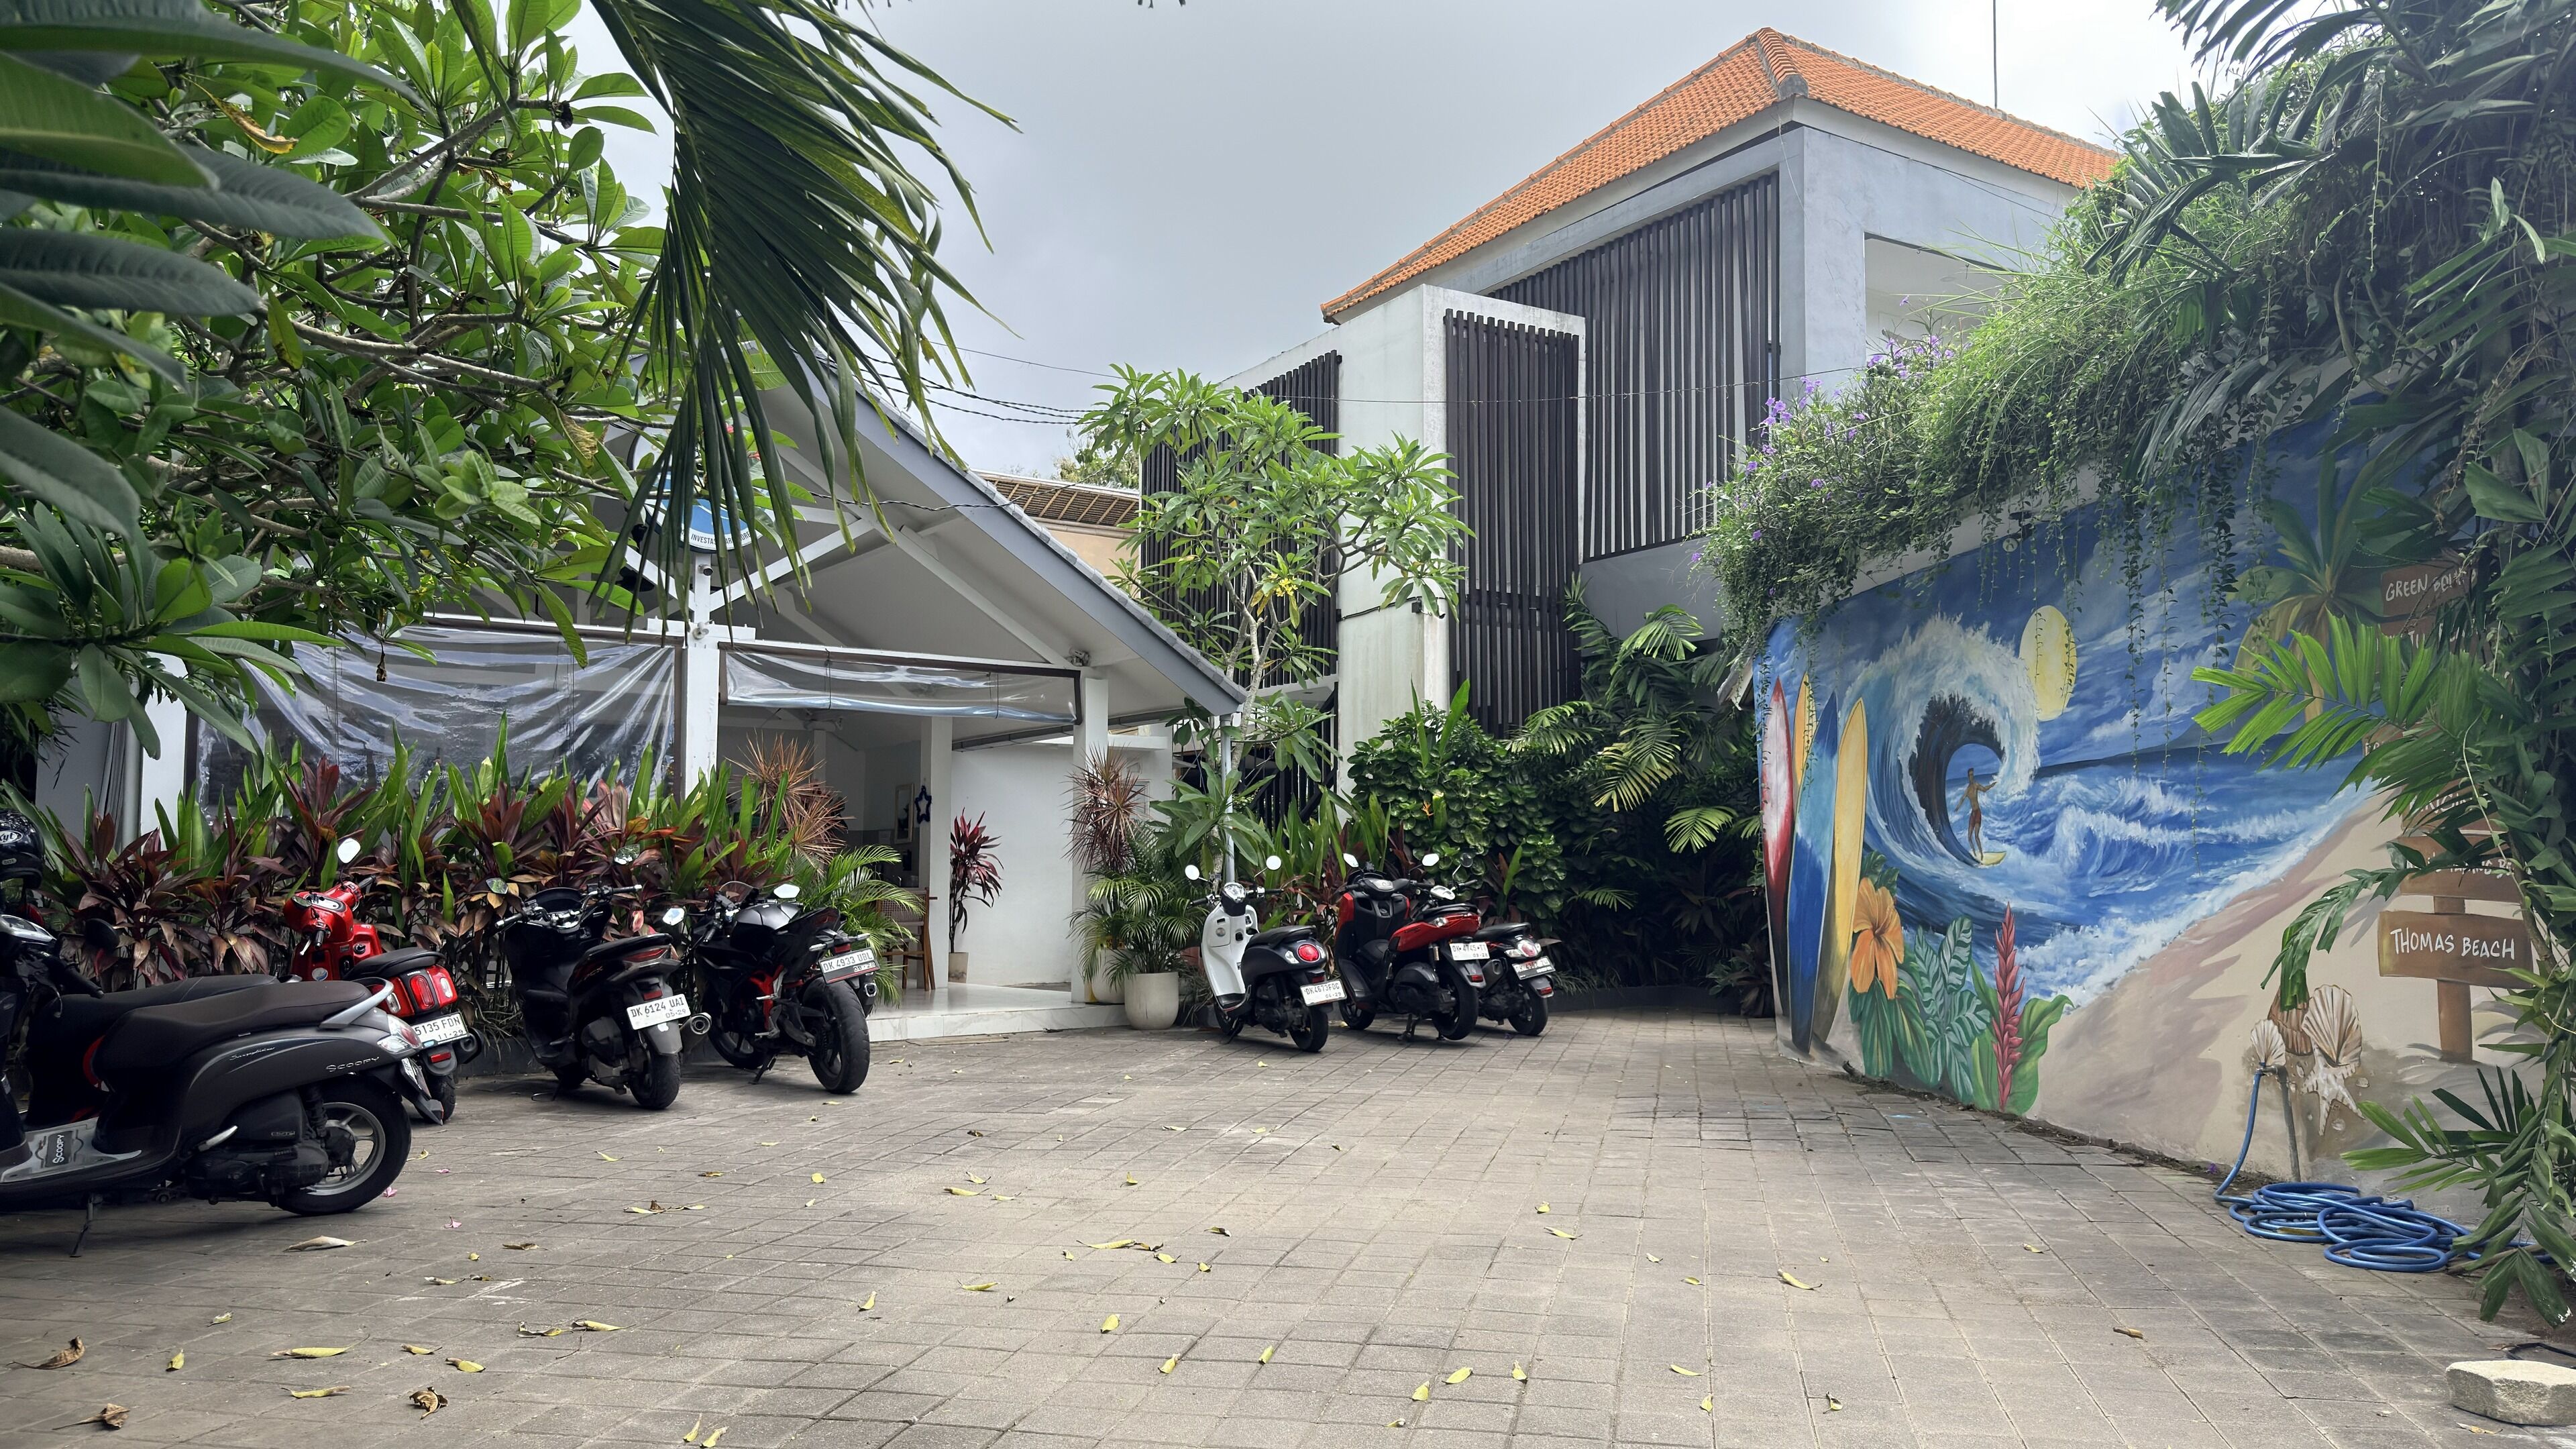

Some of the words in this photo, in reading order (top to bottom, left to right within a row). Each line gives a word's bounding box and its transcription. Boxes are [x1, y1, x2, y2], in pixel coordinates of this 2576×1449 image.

[2385, 574, 2428, 602] GREEN
[2390, 927, 2455, 955] THOMAS
[2461, 936, 2515, 960] BEACH
[823, 961, 835, 971] DK
[837, 956, 856, 967] 4933
[857, 952, 873, 962] UBL
[631, 1008, 643, 1018] DK
[645, 1002, 666, 1014] 6124
[669, 997, 685, 1008] UAI
[415, 1022, 440, 1036] 5135
[441, 1016, 461, 1028] FDN
